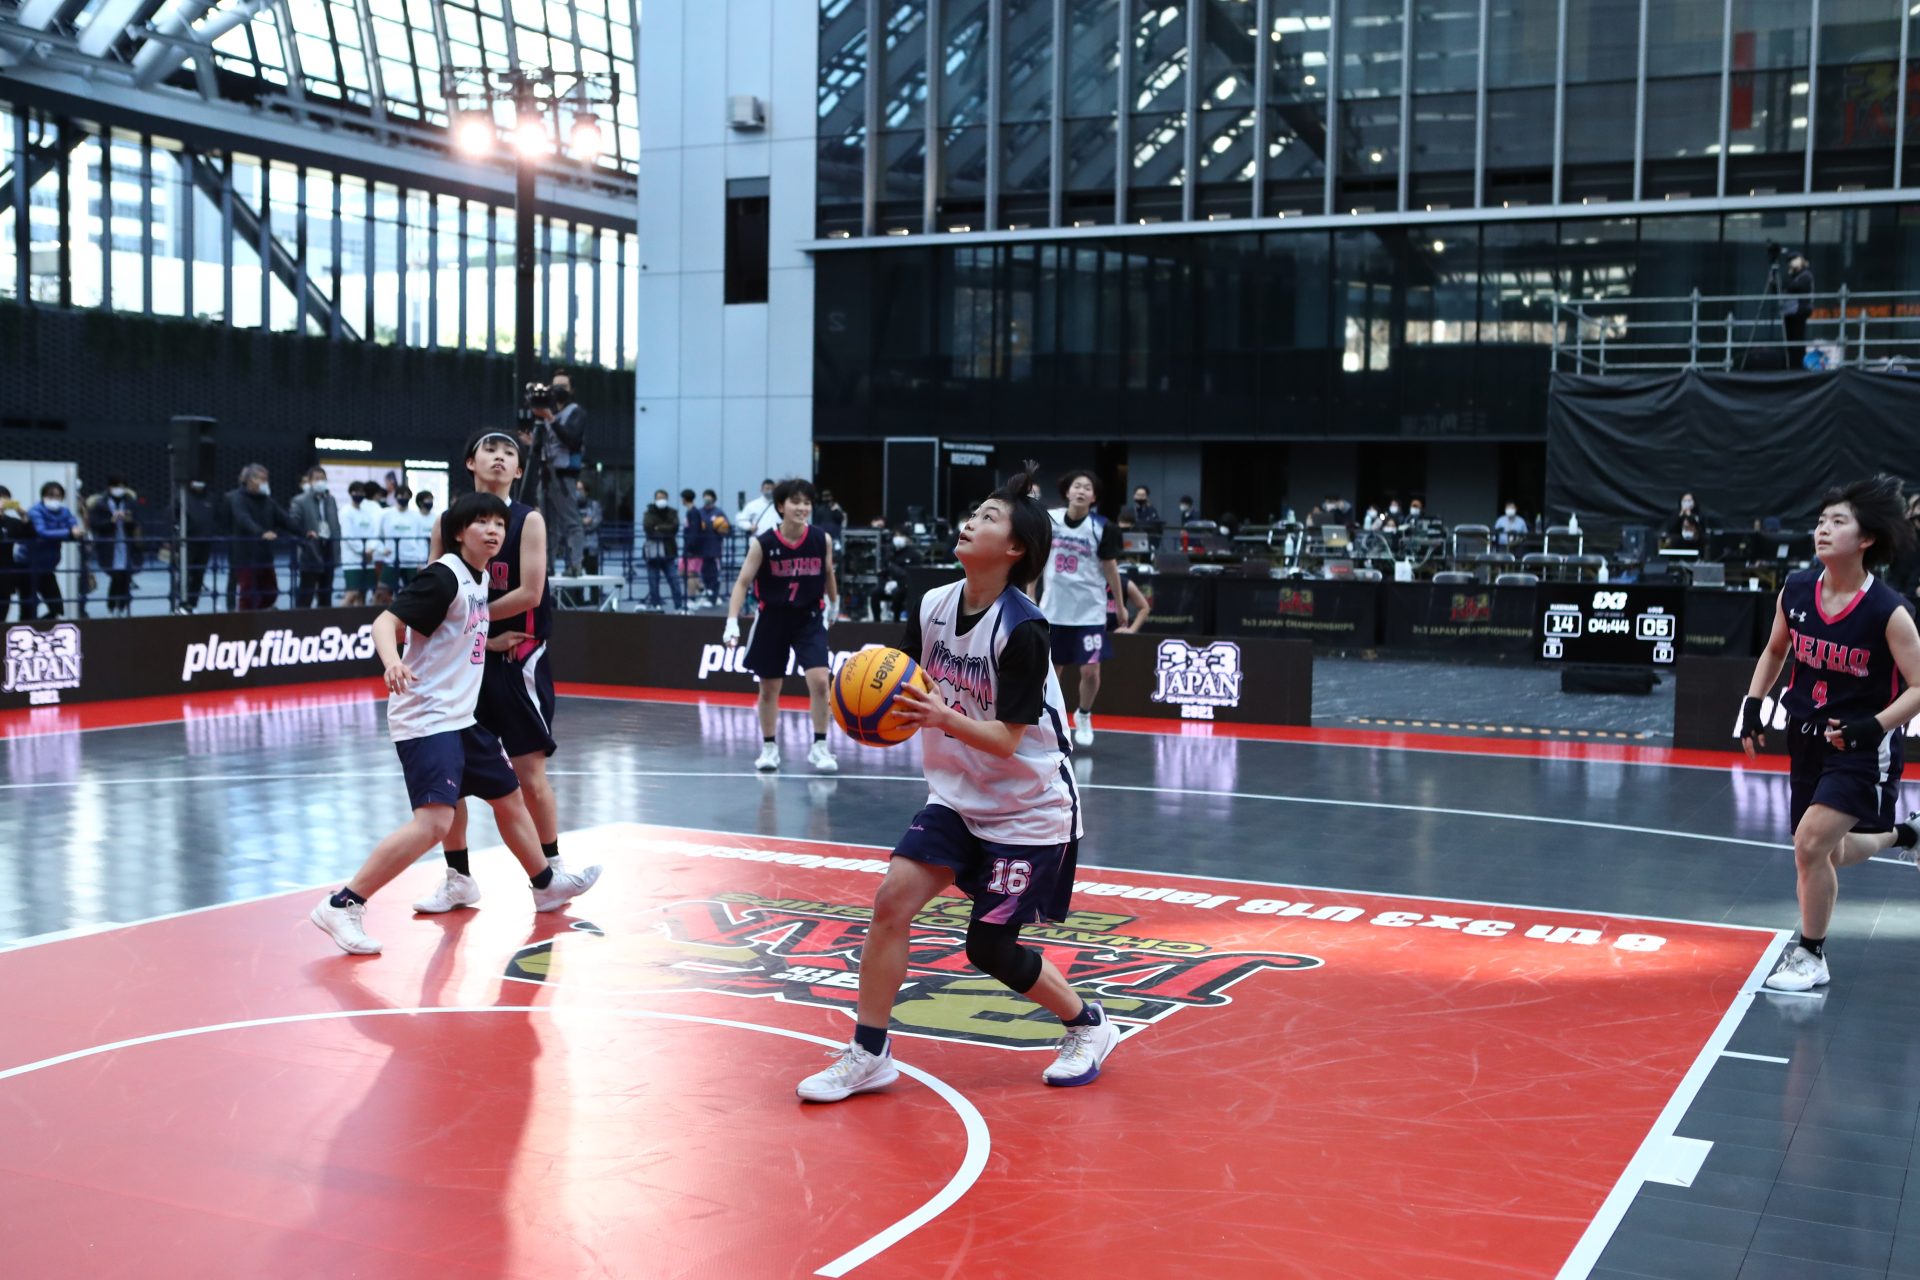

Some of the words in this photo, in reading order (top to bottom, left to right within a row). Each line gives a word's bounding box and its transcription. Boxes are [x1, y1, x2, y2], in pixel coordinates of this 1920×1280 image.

[1055, 553, 1078, 574] 89
[788, 582, 800, 602] 7
[1258, 619, 1284, 629] JAPAN
[1285, 619, 1355, 631] CHAMPIONSHIPS
[1430, 626, 1457, 636] JAPAN
[1458, 626, 1533, 638] CHAMPIONSHIPS
[1552, 615, 1574, 633] 14
[1588, 618, 1630, 634] 04:44
[1642, 618, 1669, 636] 05
[1083, 634, 1102, 652] 89
[1157, 639, 1241, 674] 3x3
[2, 655, 82, 692] JAPAN
[868, 649, 902, 691] molten
[1150, 669, 1243, 702] JAPAN
[987, 857, 1032, 896] 16
[1235, 898, 1366, 922] U18
[1369, 911, 1516, 937] 3x3
[1524, 923, 1603, 945] th
[1612, 933, 1667, 951] 8
